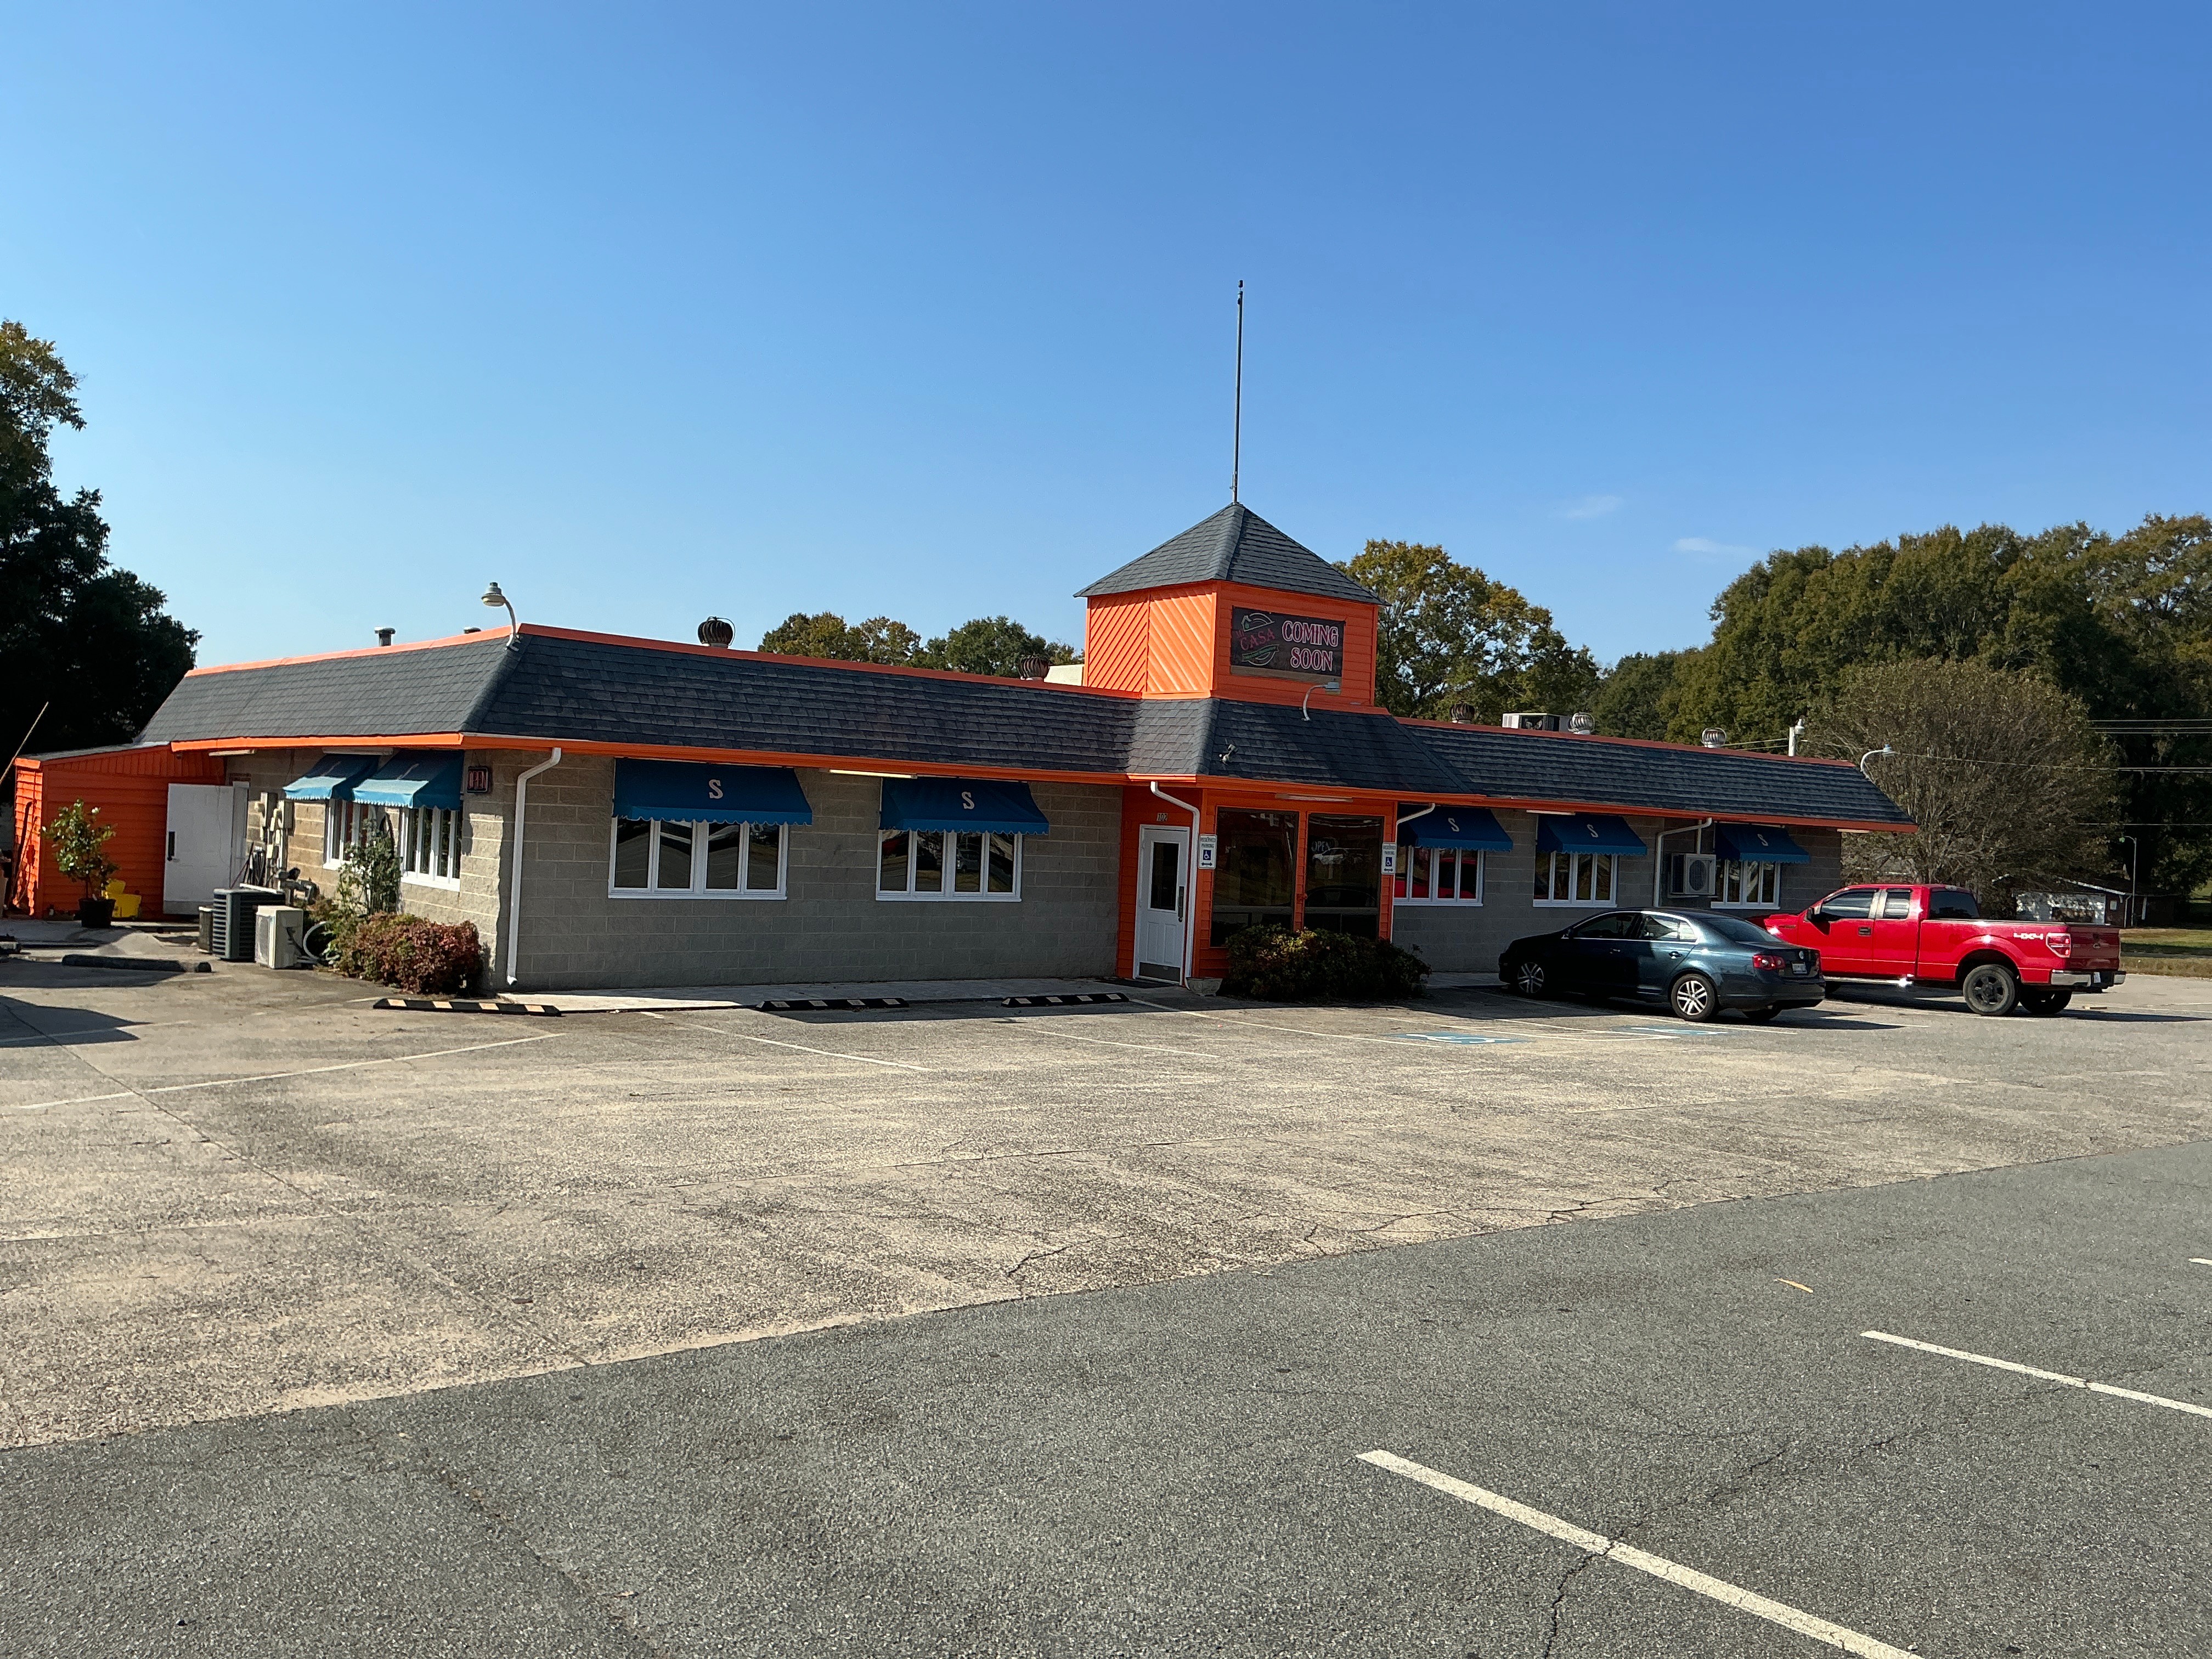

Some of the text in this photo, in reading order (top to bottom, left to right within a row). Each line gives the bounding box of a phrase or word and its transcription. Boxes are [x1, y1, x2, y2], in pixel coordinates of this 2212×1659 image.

[1240, 628, 1276, 651] CASA
[1282, 620, 1339, 647] COMING
[1290, 647, 1333, 671] SOON
[709, 780, 723, 799] S
[962, 792, 974, 809] S
[1158, 813, 1168, 822] 102
[1448, 817, 1459, 832] S
[1587, 824, 1599, 838] S
[1757, 833, 1769, 846] S
